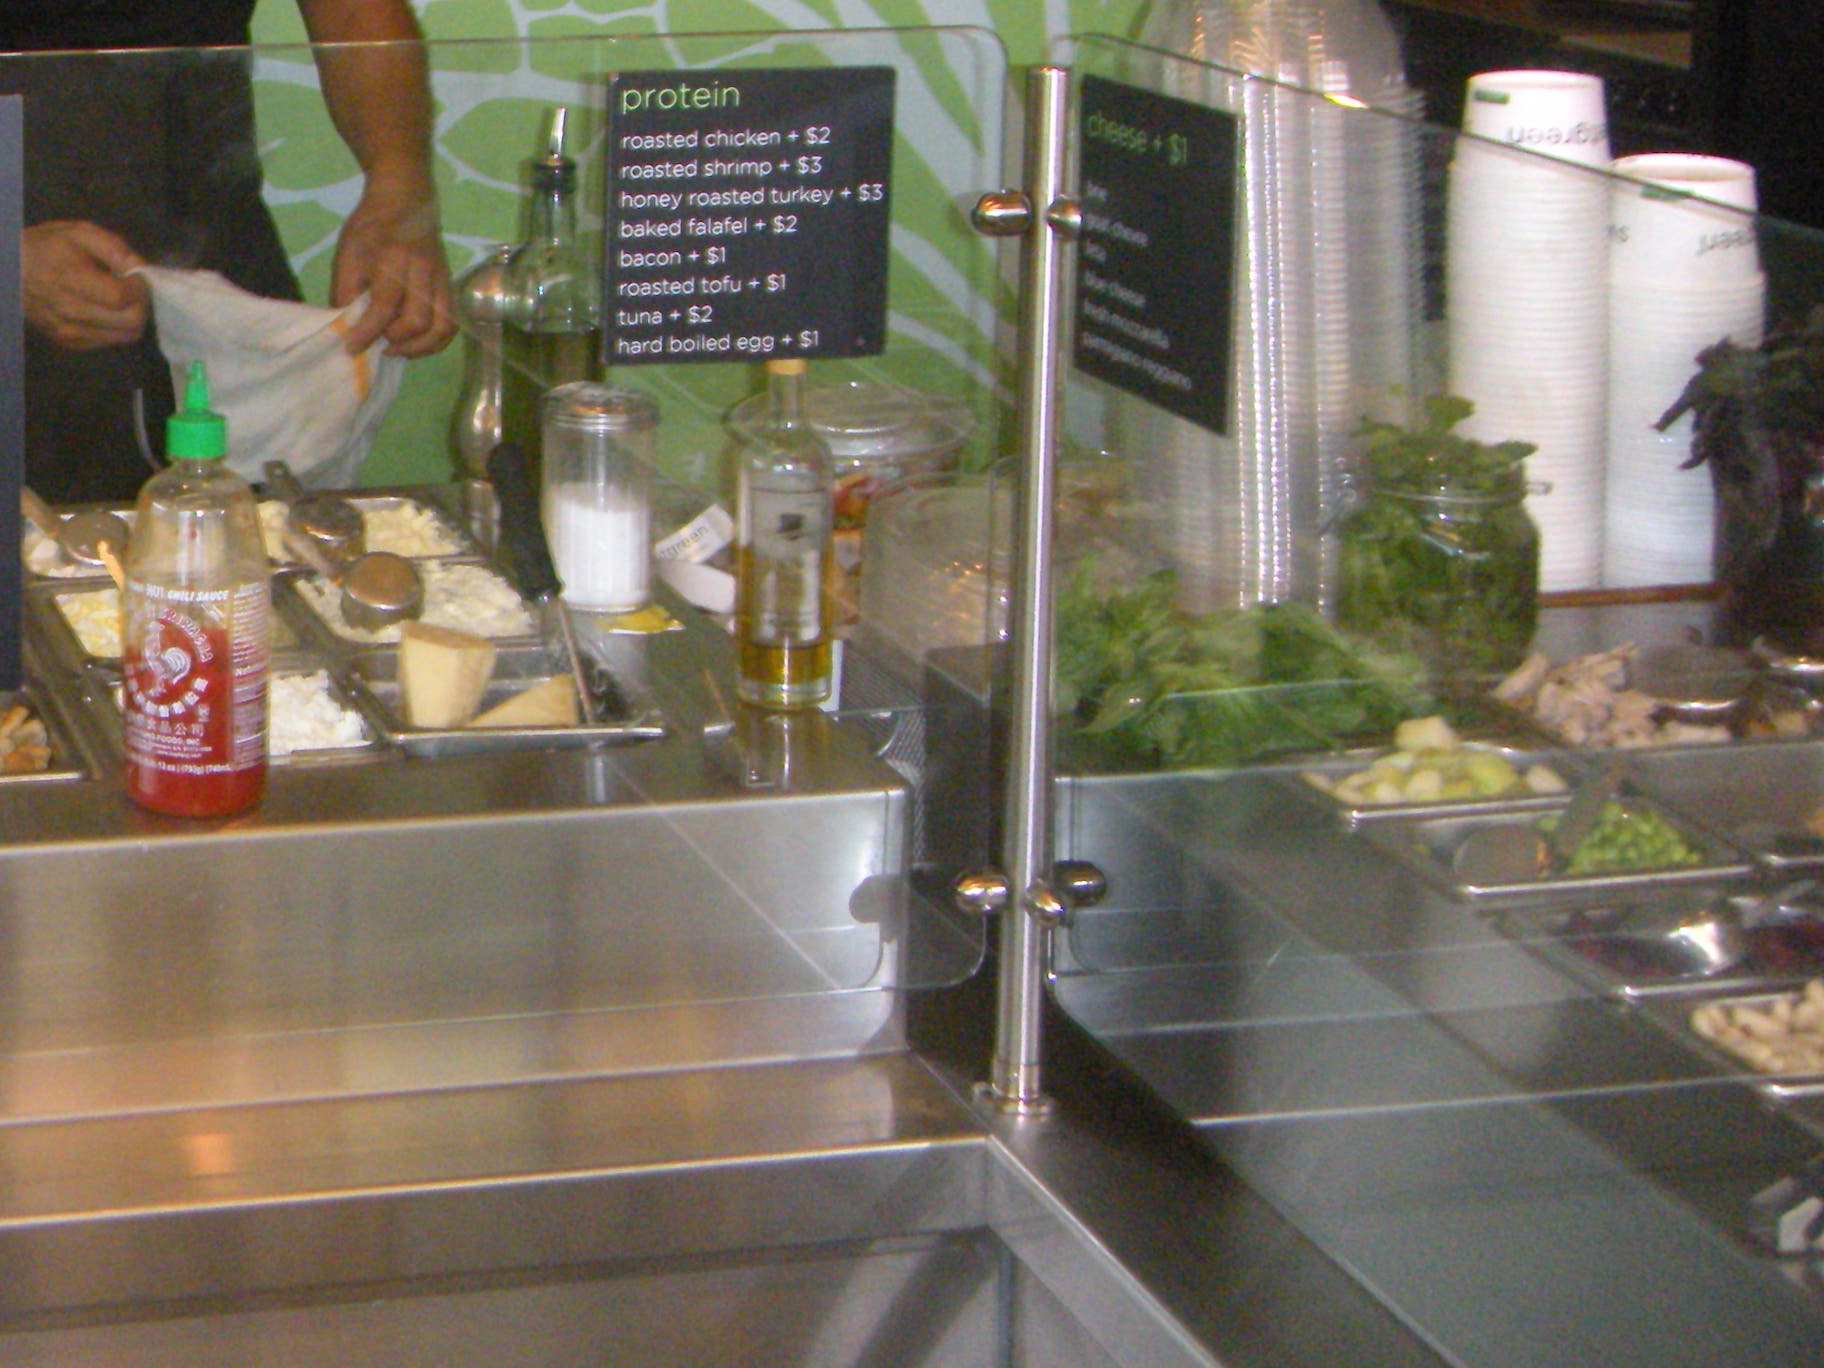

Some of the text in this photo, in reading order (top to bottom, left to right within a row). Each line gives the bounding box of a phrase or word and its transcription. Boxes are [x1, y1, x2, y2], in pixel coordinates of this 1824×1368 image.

[622, 81, 740, 114] protein
[622, 126, 831, 150] roasted chicken $2
[621, 155, 823, 179] roasted shrimp $3
[621, 183, 884, 210] honey roasted turkey $3
[620, 215, 798, 238] baked falafel $2
[620, 246, 726, 267] bacon $1
[619, 273, 787, 297] roasted tofu $1
[618, 304, 713, 326] tuna $2
[618, 330, 820, 354] hard boiled egg $1
